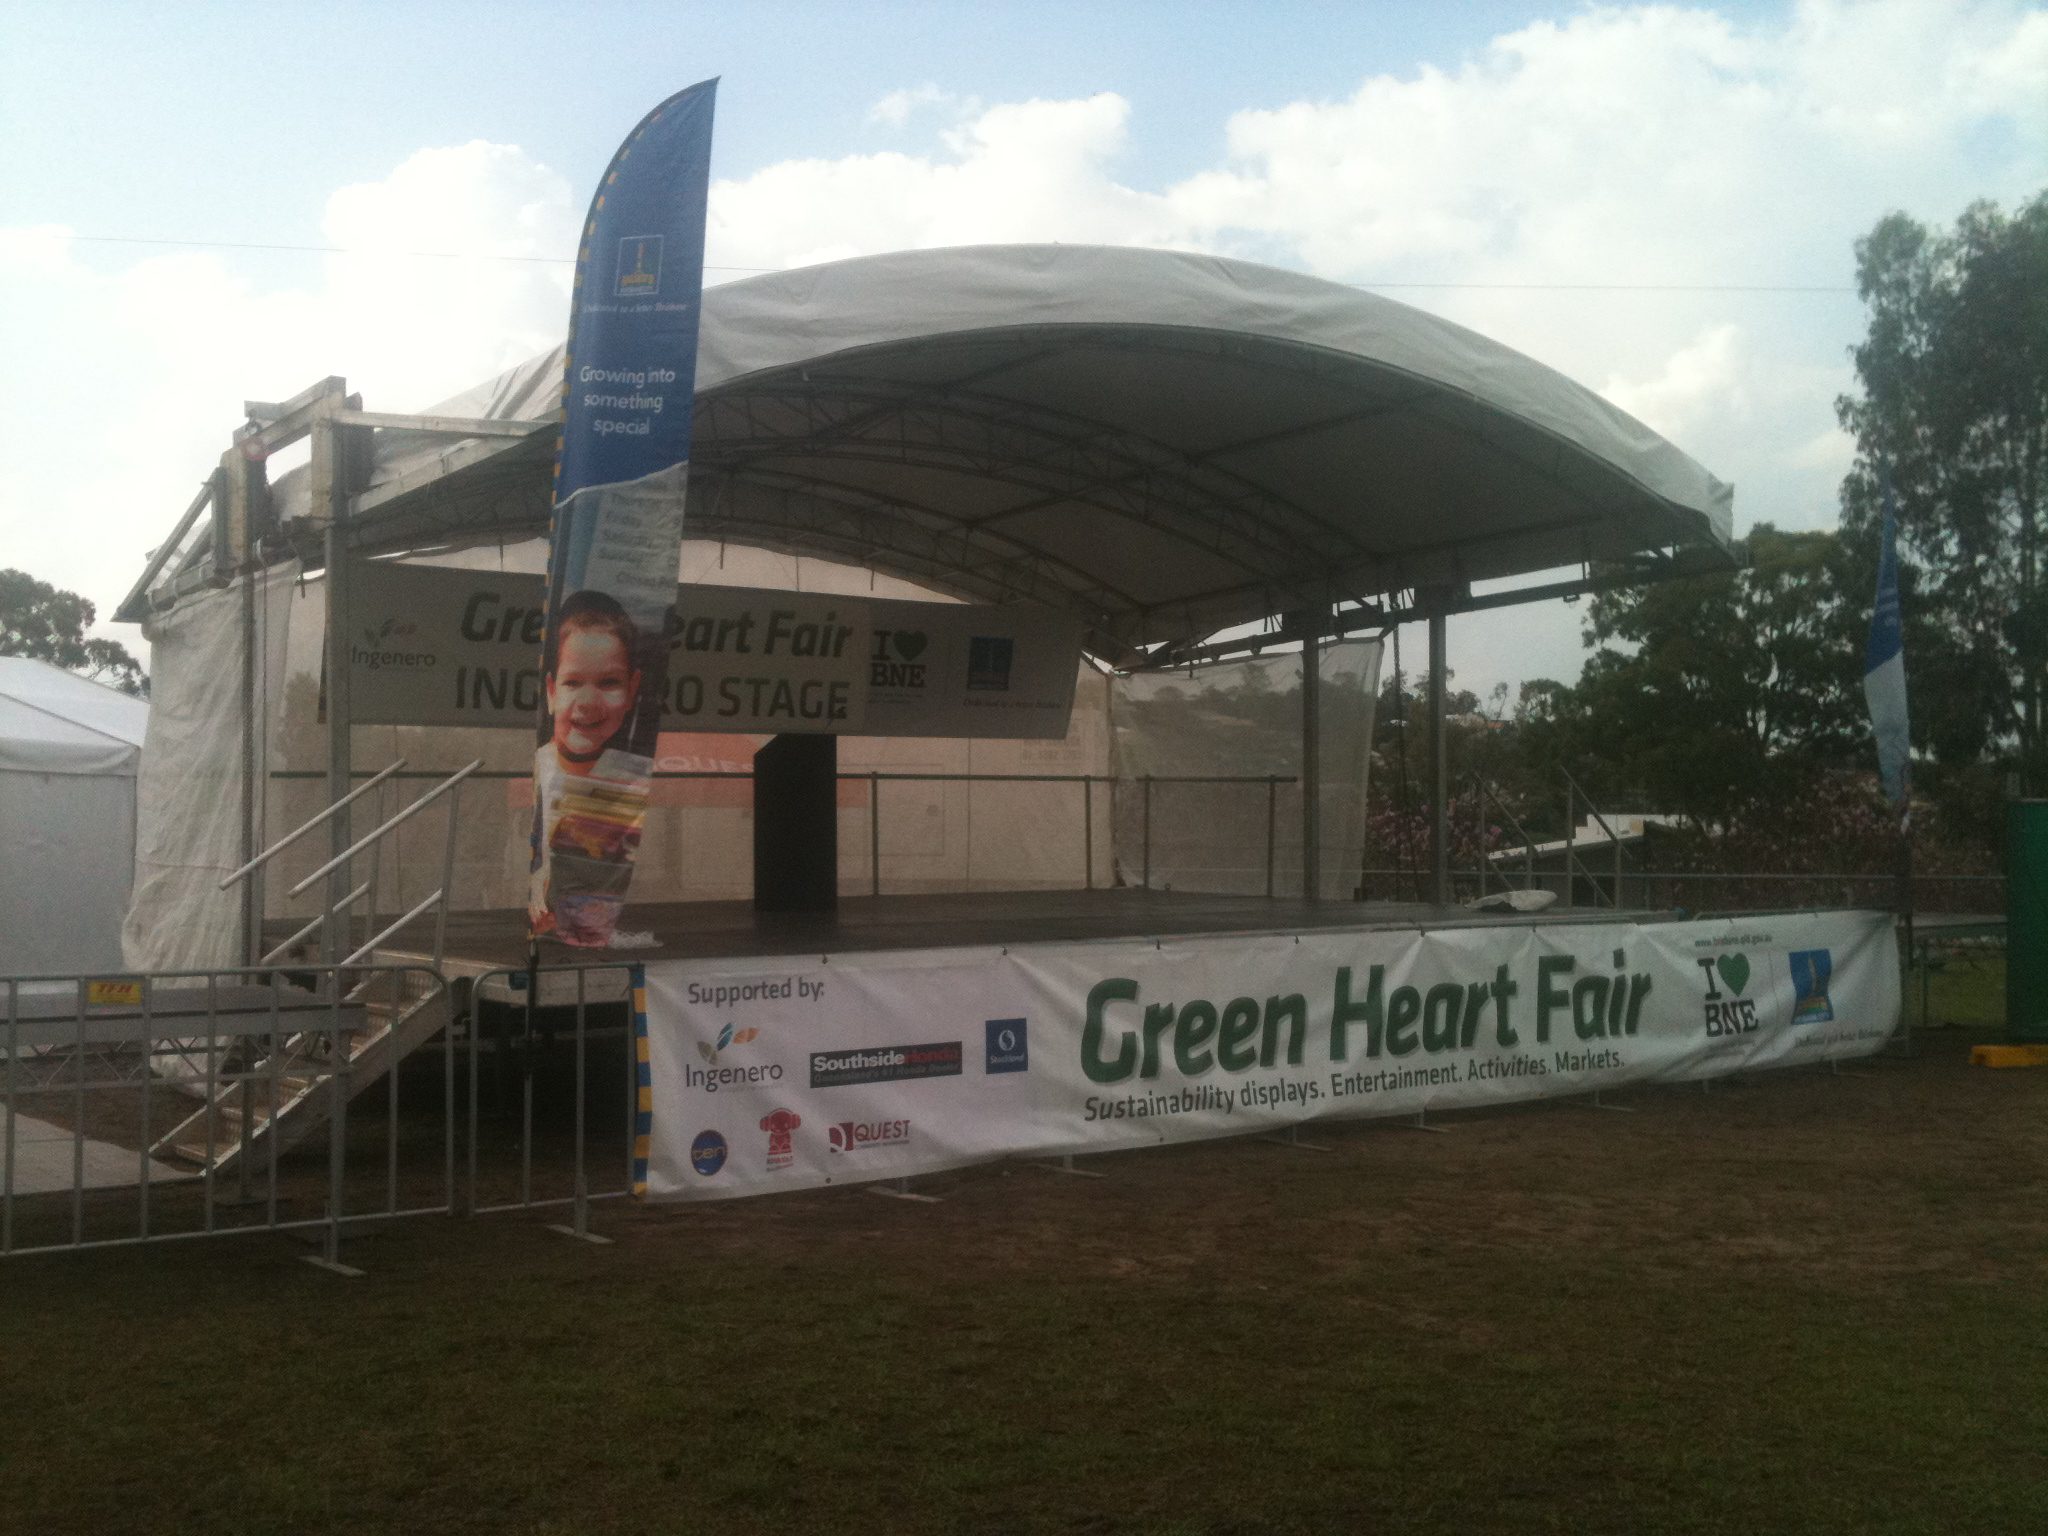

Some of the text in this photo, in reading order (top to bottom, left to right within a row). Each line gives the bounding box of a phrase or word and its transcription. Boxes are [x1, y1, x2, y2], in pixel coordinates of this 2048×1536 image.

[581, 365, 676, 388] Growing into
[584, 393, 664, 413] something
[593, 418, 650, 436] special
[764, 610, 853, 659] Fair
[872, 630, 893, 662] I
[351, 646, 436, 670] Ingenero
[870, 662, 927, 689] BNE
[717, 675, 850, 719] STAGE
[688, 977, 825, 1007] Supported by:
[1697, 957, 1721, 1000] I
[1081, 948, 1653, 1084] Green Heart Fair
[1705, 998, 1758, 1037] BNE
[813, 1050, 905, 1072] Southside
[685, 1062, 783, 1093] Ingenero
[1084, 1048, 1625, 1122] Sustainability displays. Entertainment. Activities. Markets.
[854, 1120, 911, 1142] QUEST
